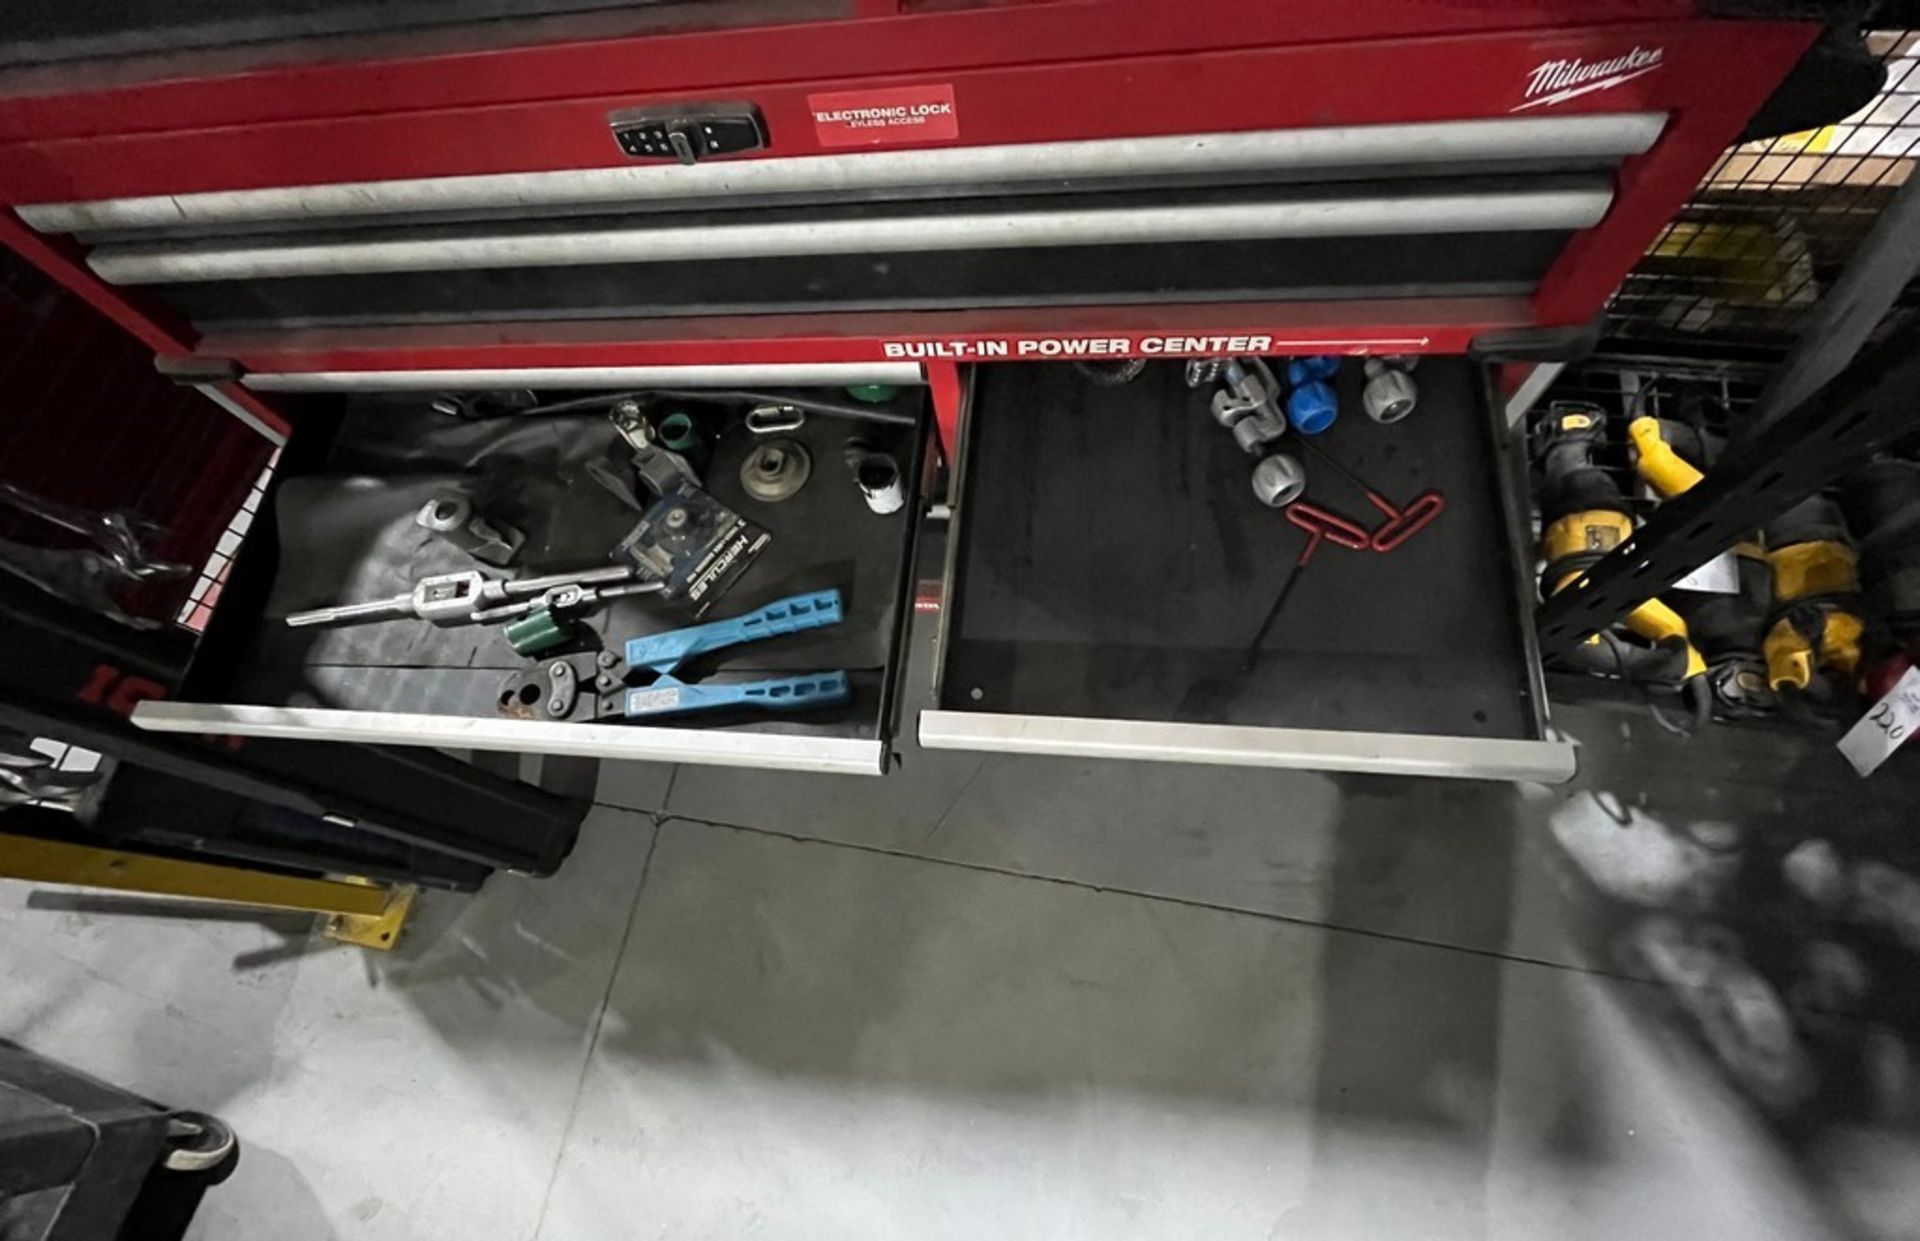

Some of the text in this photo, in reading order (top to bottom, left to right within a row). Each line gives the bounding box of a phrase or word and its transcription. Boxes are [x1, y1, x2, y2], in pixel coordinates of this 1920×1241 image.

[1525, 45, 1664, 98] Milwaukee
[815, 103, 951, 122] ELECTRONIC LOCK
[888, 116, 926, 126] ACCESS
[883, 335, 1272, 358] BUILT-IN POWER CENTER
[689, 534, 749, 601] HERCULES
[1868, 702, 1904, 740] 220
